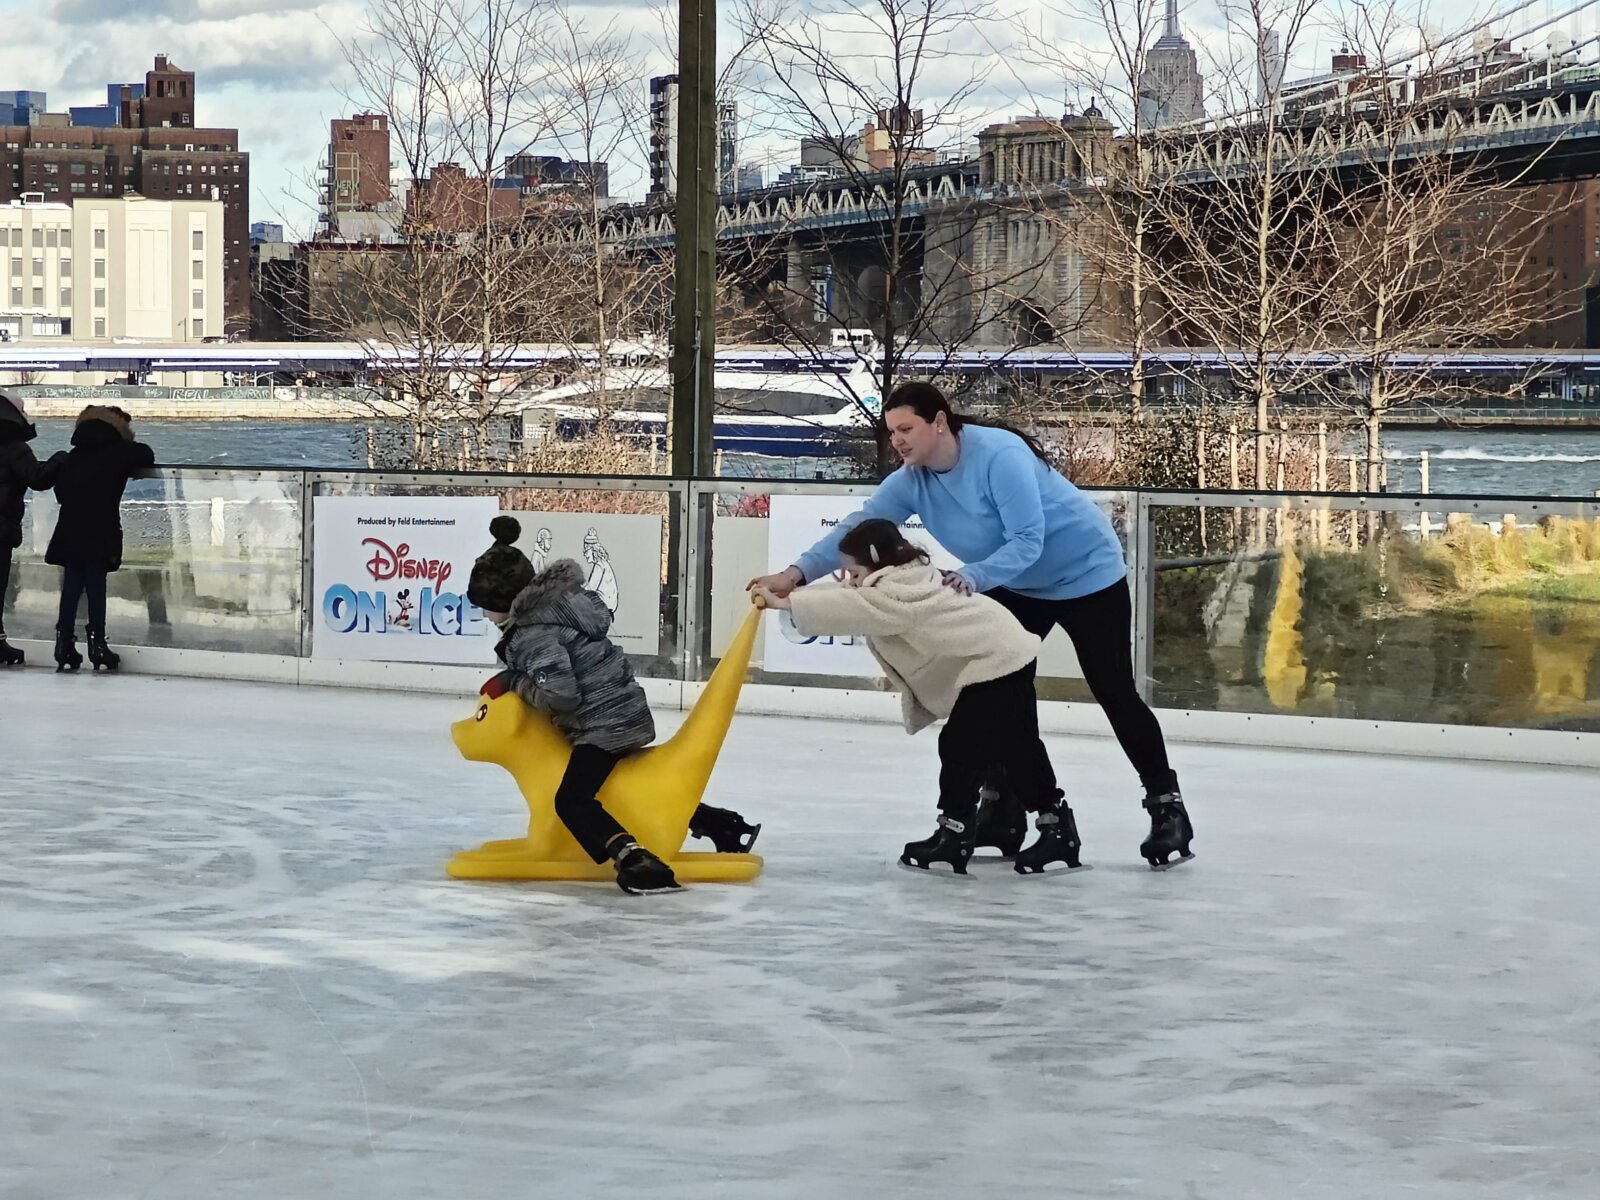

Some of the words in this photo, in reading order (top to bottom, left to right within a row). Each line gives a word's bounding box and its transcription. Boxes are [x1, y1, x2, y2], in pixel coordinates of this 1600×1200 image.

[357, 517, 387, 525] Produced
[387, 517, 396, 527] by
[397, 517, 411, 525] Feld
[411, 517, 456, 526] Entertainment
[322, 583, 387, 633] ON
[418, 586, 488, 636] ICE
